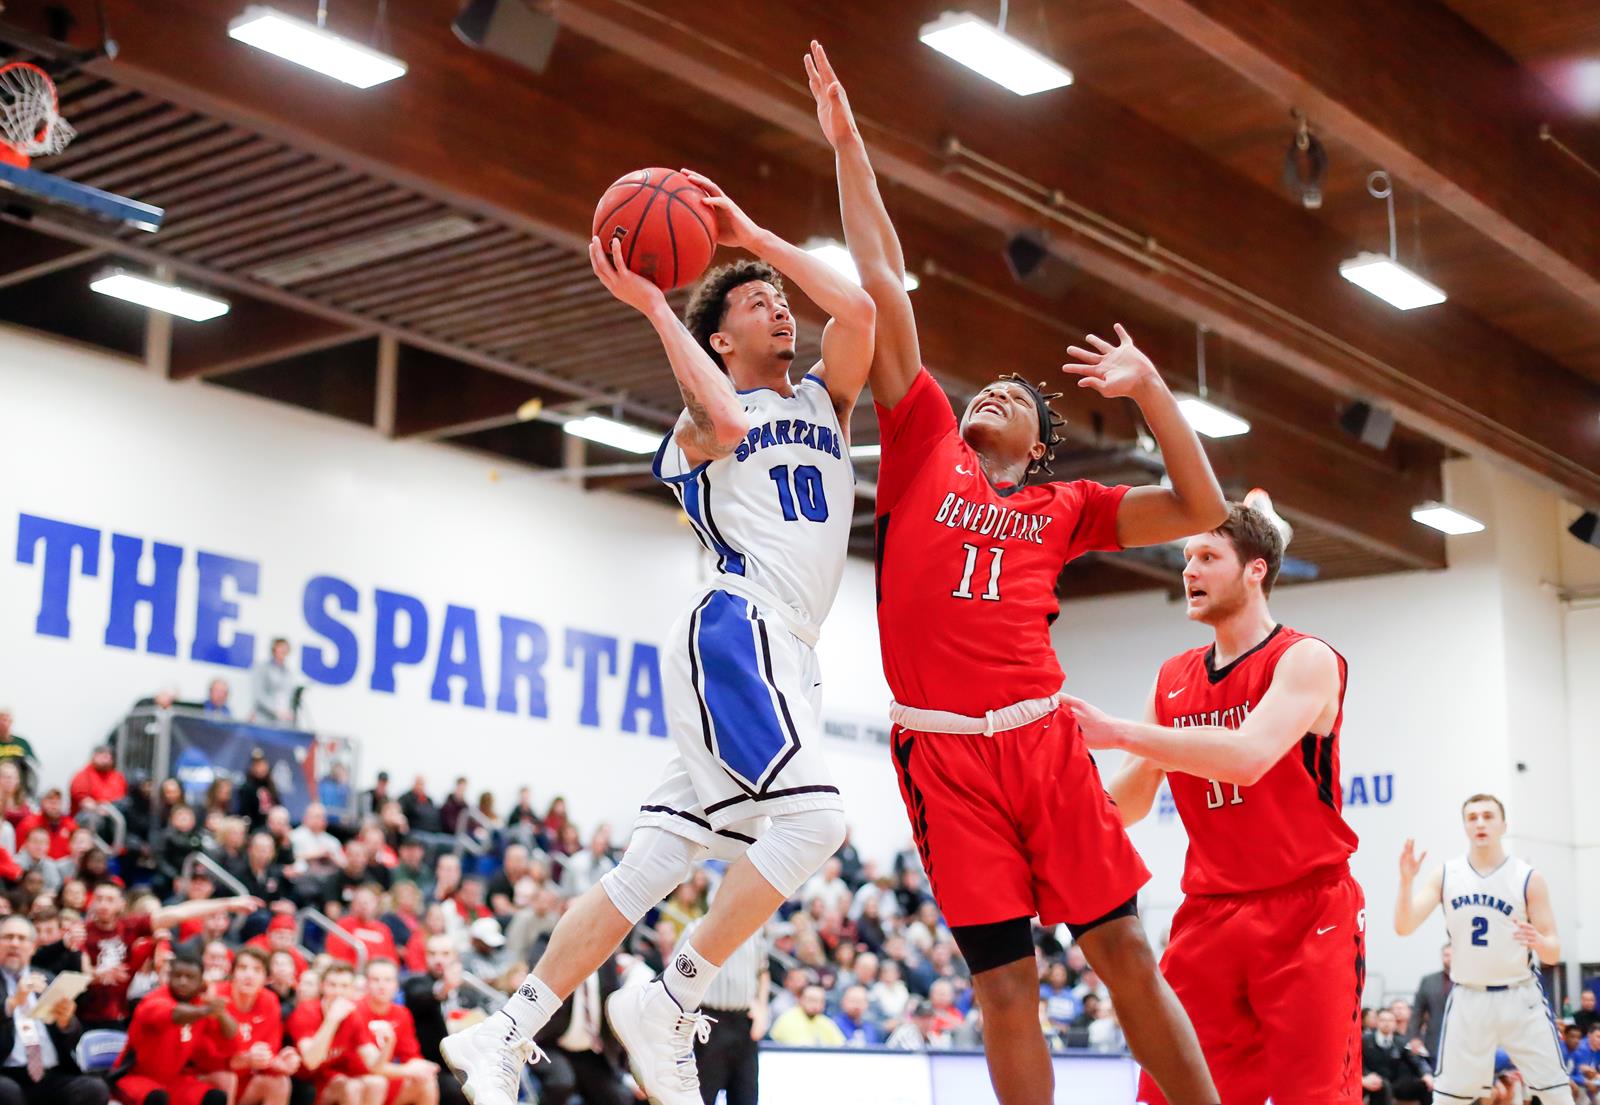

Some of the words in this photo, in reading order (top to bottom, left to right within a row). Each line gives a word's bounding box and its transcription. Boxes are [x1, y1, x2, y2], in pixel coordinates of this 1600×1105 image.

[735, 418, 842, 463] SPARTANS
[768, 464, 829, 523] 10
[951, 542, 1005, 601] 11
[15, 512, 260, 670] THE
[301, 575, 668, 738] SPARTA
[1343, 774, 1393, 806] AU
[1451, 893, 1514, 917] SPARTANS
[1471, 916, 1489, 947] 2
